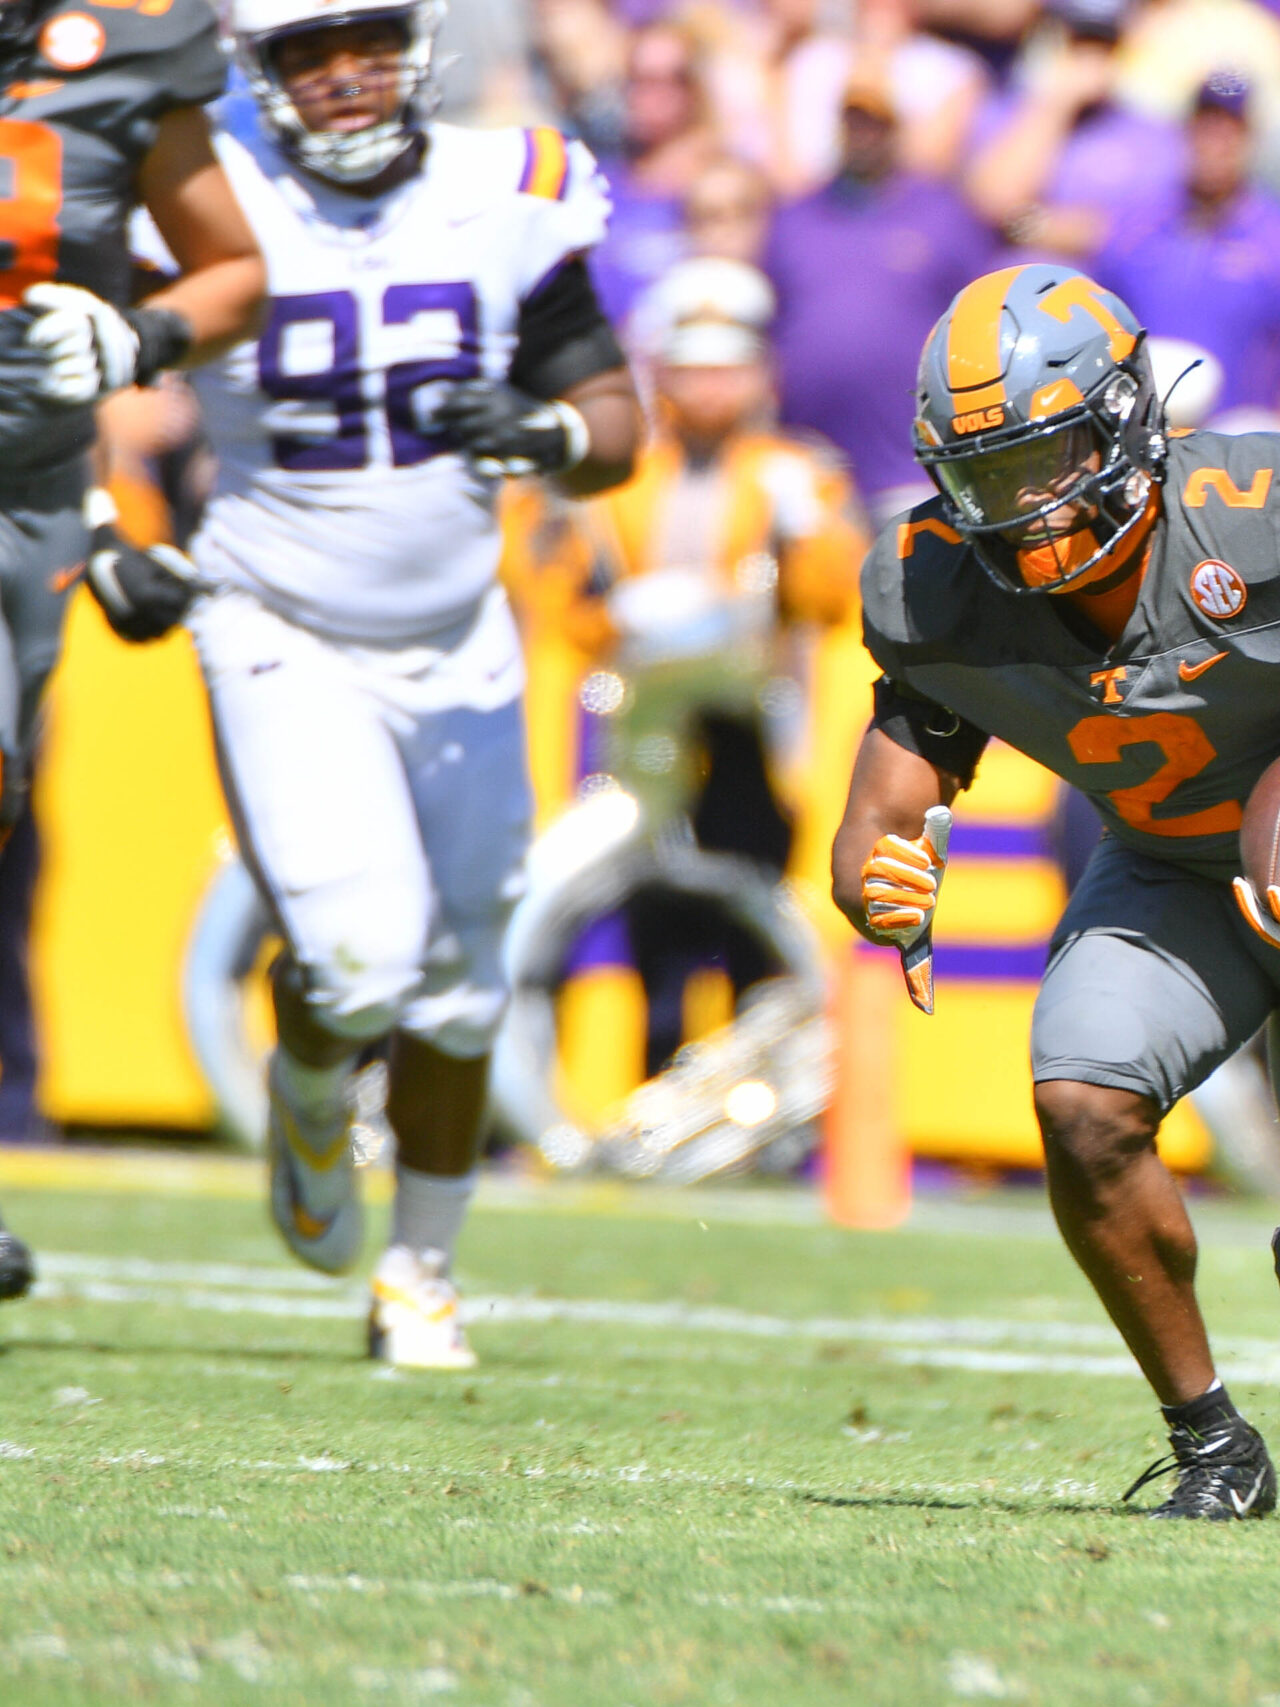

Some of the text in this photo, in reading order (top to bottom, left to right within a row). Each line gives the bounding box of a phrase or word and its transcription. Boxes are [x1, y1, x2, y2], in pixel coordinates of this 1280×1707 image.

[257, 281, 482, 472] 92
[951, 406, 1005, 436] VOLS
[1182, 467, 1274, 508] 2
[1194, 563, 1242, 616] SEC
[1089, 665, 1127, 704] T
[1066, 712, 1243, 838] 2
